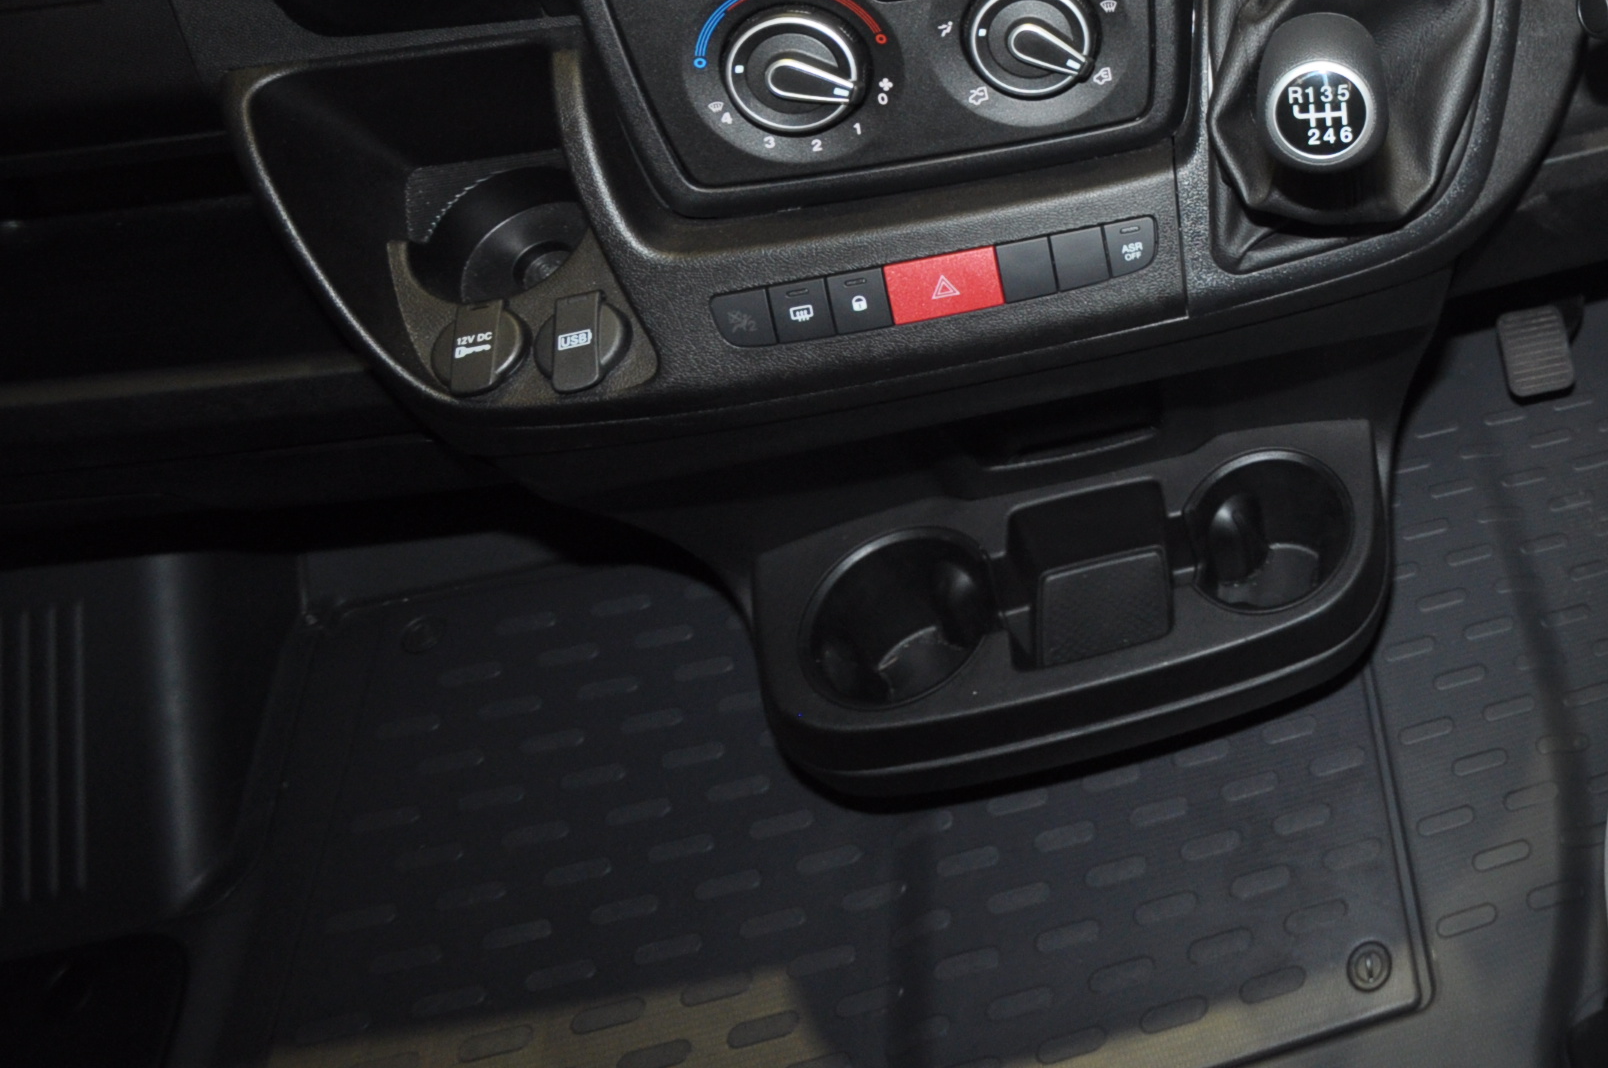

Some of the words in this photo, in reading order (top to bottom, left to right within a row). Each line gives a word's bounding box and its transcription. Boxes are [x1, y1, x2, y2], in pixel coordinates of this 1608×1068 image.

[877, 93, 888, 105] 0
[1288, 86, 1303, 104] R
[1305, 87, 1314, 102] 1
[1320, 86, 1333, 102] 3
[1337, 84, 1349, 101] 5
[721, 112, 733, 124] 4
[853, 122, 862, 135] 1
[763, 136, 775, 148] 3
[1308, 129, 1320, 145] 2
[1323, 128, 1336, 144] 4
[1340, 126, 1353, 143] 6
[811, 139, 823, 152] 2
[1122, 242, 1143, 253] ASR
[1124, 251, 1141, 261] OFF
[457, 334, 475, 345] 12V
[477, 332, 492, 341] DC
[560, 333, 587, 347] USB
